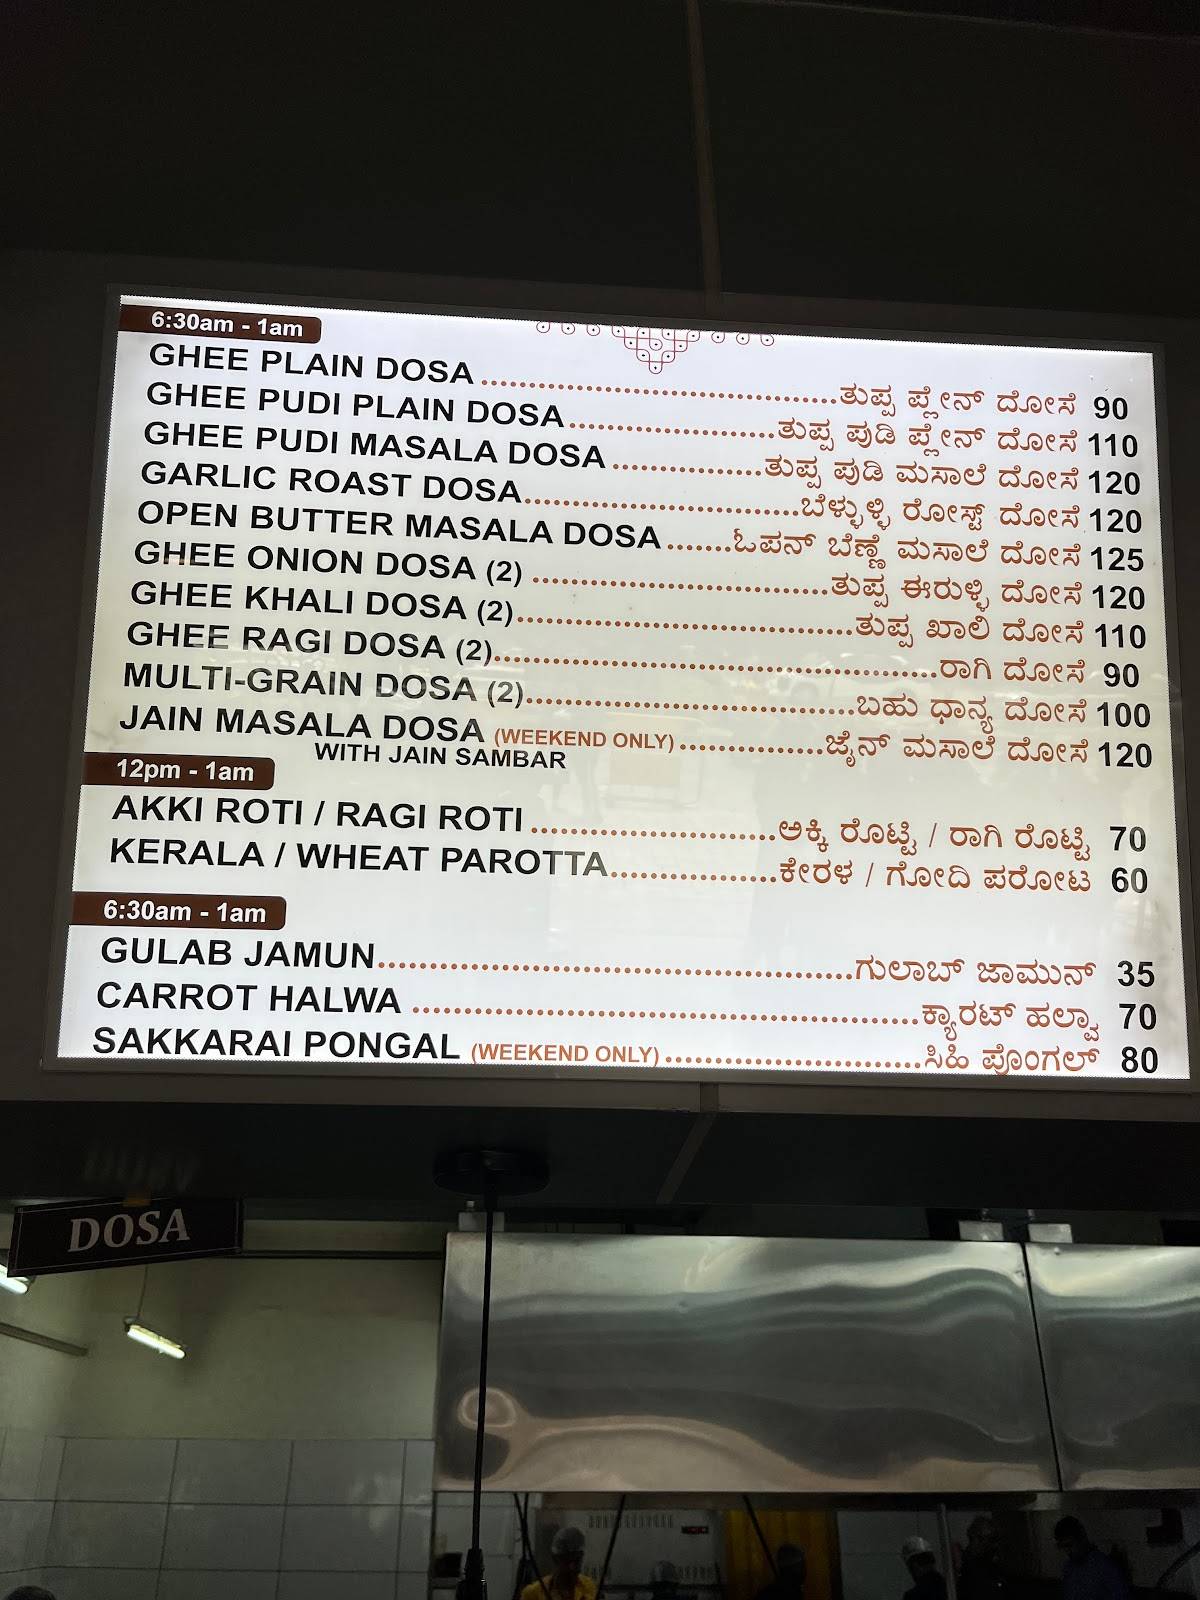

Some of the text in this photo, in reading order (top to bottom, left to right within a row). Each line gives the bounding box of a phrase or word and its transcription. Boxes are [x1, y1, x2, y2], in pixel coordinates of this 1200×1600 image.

[151, 310, 234, 334] 6:30am
[257, 317, 303, 337] 1am
[150, 343, 474, 384] GHEE PLAIN DOSA
[147, 382, 564, 427] GHEE PUDI PLAIN DOSA
[841, 383, 895, 417] ತುಪ್ಪ
[997, 390, 1076, 415] ದೋಸೆ
[1094, 397, 1128, 420] 90
[145, 422, 605, 468] GHEE PUDI MASALA DOSA
[779, 417, 834, 451] ತುಪ್ಪ
[847, 421, 895, 448] ಪುಡಿ
[998, 428, 1077, 452] ದೋಸೆ
[1089, 433, 1137, 457] 110
[142, 461, 522, 503] GARLIC ROAST DOSA
[765, 455, 1078, 490] ತುಪ್ಪ ಪುಡಿ ಮಸಾಲೆ ದೋಸೆ
[1089, 471, 1140, 495] 120
[138, 501, 661, 549] OPEN BUTTER MASALA DOSA
[1000, 503, 1080, 528] ದೋಸೆ
[1090, 508, 1141, 533] 120
[135, 541, 521, 587] GHEE ONION DOSA (2)
[734, 528, 1081, 569] ಓಪನ್ ಬೆಣ್ಣೆ ಮಸಾಲೆ ದೋಸೆ
[1091, 547, 1144, 571] 125
[131, 581, 512, 627] GHEE KHALI DOSA (2)
[832, 572, 1082, 612] ತುಪ್ಪ ಈರುಳ್ಳಿ ದೋಸೆ
[1093, 585, 1145, 610] 120
[128, 622, 491, 666] GHEE RAGI DOSA (2)
[856, 613, 1084, 648] ತುಪ್ಪ ಖಾಲಿ ದೋಸೆ
[1095, 624, 1146, 649] 110
[940, 657, 1085, 683] ರಾಗಿ ದೋಸೆ
[1104, 663, 1139, 687] 90
[124, 663, 523, 709] MULTI-GRAIN DOSA (2)
[120, 705, 674, 753] JAIN MASALA DOSA (WEEKEND ONLY)
[857, 693, 1087, 734] ಬಹು ಧಾನ್ಯ ದೋಸೆ
[1097, 702, 1150, 728] 100
[315, 743, 566, 769] WITH JAIN SAMBAR
[826, 731, 1088, 767] ಜೈನ್ ಮಸಾಲೆ ದೋಸೆ
[1099, 742, 1152, 768] 120
[118, 759, 180, 782] 12pm
[206, 761, 253, 781] 1am
[112, 795, 522, 831] AKKI ROTI / RAGI ROTI
[779, 818, 1090, 861] ಅಕ್ಕಿ ರೊಟ್ಟಿ / ರಾಗಿ ರೊಟ್ಟಿ
[1110, 826, 1146, 852] 70
[111, 838, 608, 876] KERALA / WHEAT PAROTTA
[780, 858, 852, 884] ಕೇರಳ
[866, 863, 873, 887] /
[984, 865, 1090, 891] ಪರೋಟ
[1112, 867, 1147, 893] 60
[104, 900, 191, 920] 6:30am
[217, 903, 265, 922] 1am
[102, 937, 374, 968] GULAB JAMUN
[856, 955, 1096, 985] ಗುಲಾಬ್ ಜಾಮುನ್
[1118, 961, 1155, 987] 35
[97, 982, 401, 1013] CARROT HALWA
[1119, 1004, 1156, 1030] 70
[93, 1027, 658, 1069] SAKKARAI PONGAL (WEEKEND ONLY)
[925, 1044, 969, 1068] ಸಿಹಿ
[1122, 1046, 1158, 1073] 80
[68, 1208, 190, 1252] DOSA
